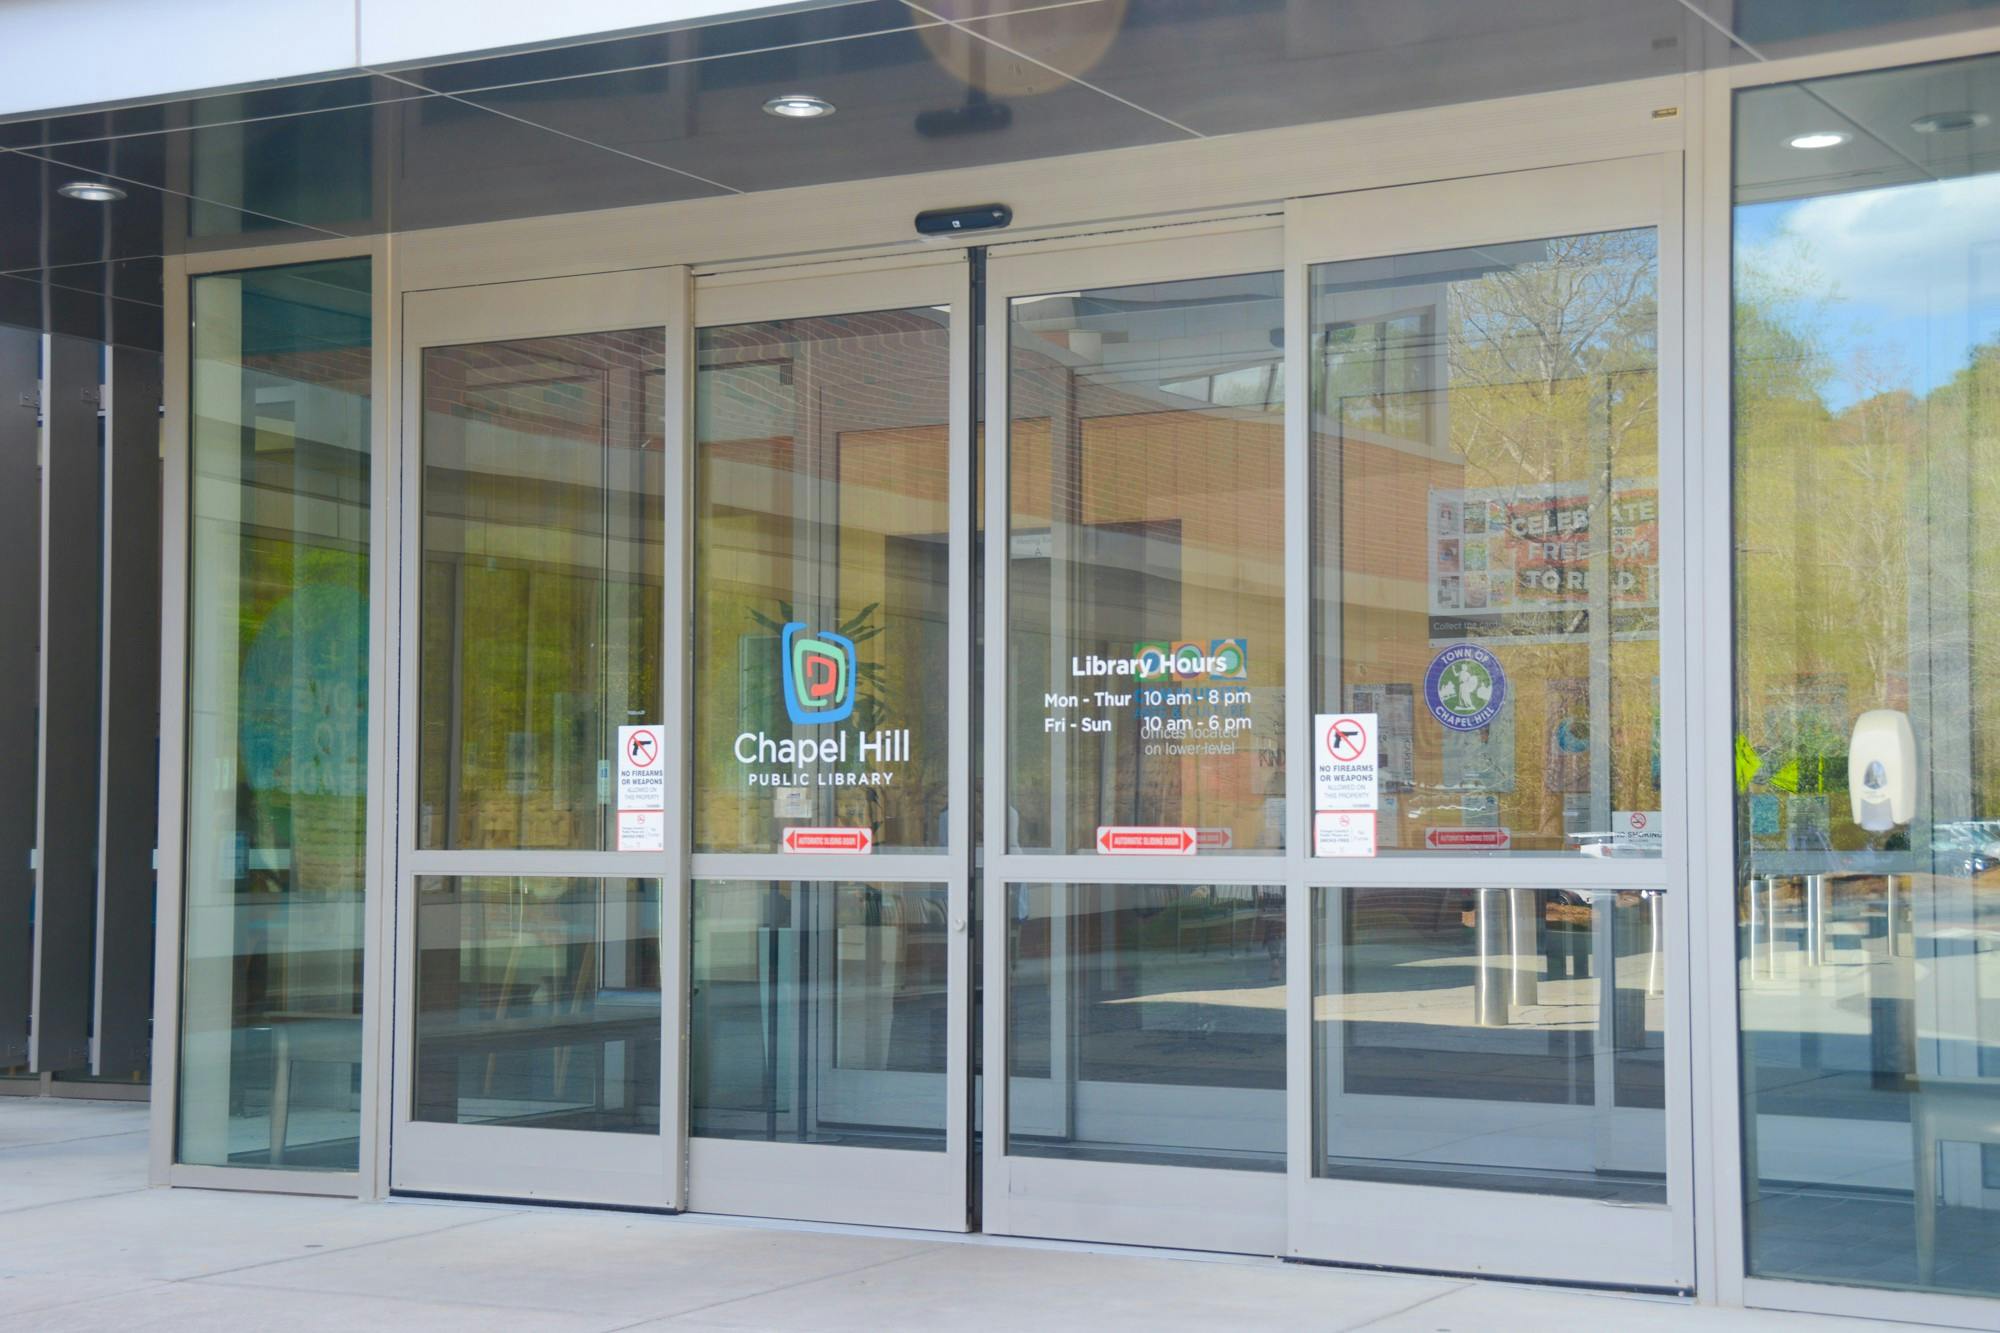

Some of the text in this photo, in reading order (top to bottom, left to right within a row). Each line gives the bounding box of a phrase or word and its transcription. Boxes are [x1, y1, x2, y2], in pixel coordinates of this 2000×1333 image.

[1512, 501, 1655, 537] CELEBATE
[1528, 540, 1649, 561] FREEOM
[1526, 570, 1560, 591] TO
[1441, 649, 1490, 665] TOWN OF
[1072, 654, 1228, 678] Library Hours
[1044, 693, 1078, 707] Mon
[1094, 692, 1132, 707] Thur
[1143, 690, 1162, 705] 10
[1166, 694, 1192, 706] am
[1208, 690, 1219, 705] 8
[1224, 692, 1252, 706] pm
[1045, 718, 1065, 732] Fri
[1081, 717, 1112, 732] Sun
[1143, 716, 1162, 731] 10
[1166, 720, 1192, 731] am
[1209, 716, 1219, 731] 6
[1225, 718, 1252, 733] pm
[1435, 706, 1495, 727] CHAPEL HILL
[1140, 726, 1239, 740] Offices located
[734, 729, 910, 768] Chapel Hill
[1144, 741, 1235, 756] on lower level
[632, 769, 663, 777] FIREARMS
[1319, 764, 1374, 773] NO FIREARMS
[748, 771, 894, 786] PUBLIC LIBRARY
[1320, 774, 1374, 782] OR WEAPONS
